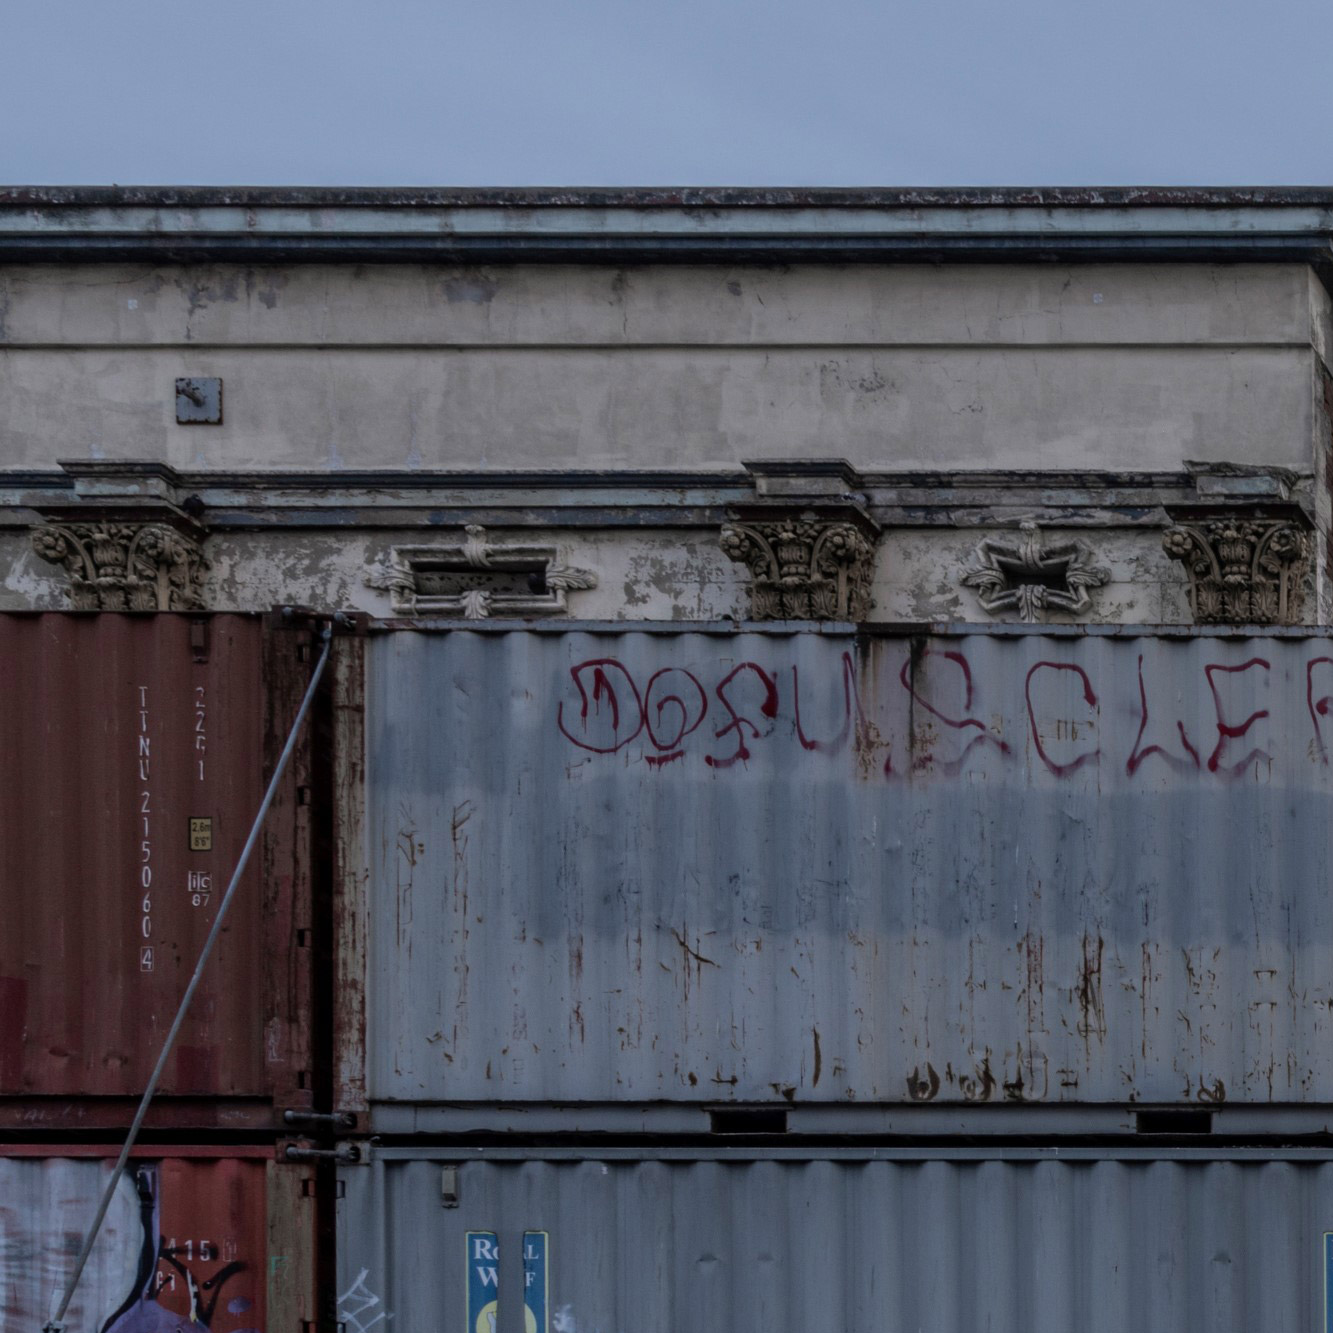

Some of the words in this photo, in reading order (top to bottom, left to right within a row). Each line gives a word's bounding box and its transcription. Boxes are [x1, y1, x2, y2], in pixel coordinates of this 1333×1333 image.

[138, 685, 151, 782] TTNU
[140, 791, 152, 938] 215060
[192, 893, 210, 907] 87
[141, 948, 153, 971] 4
